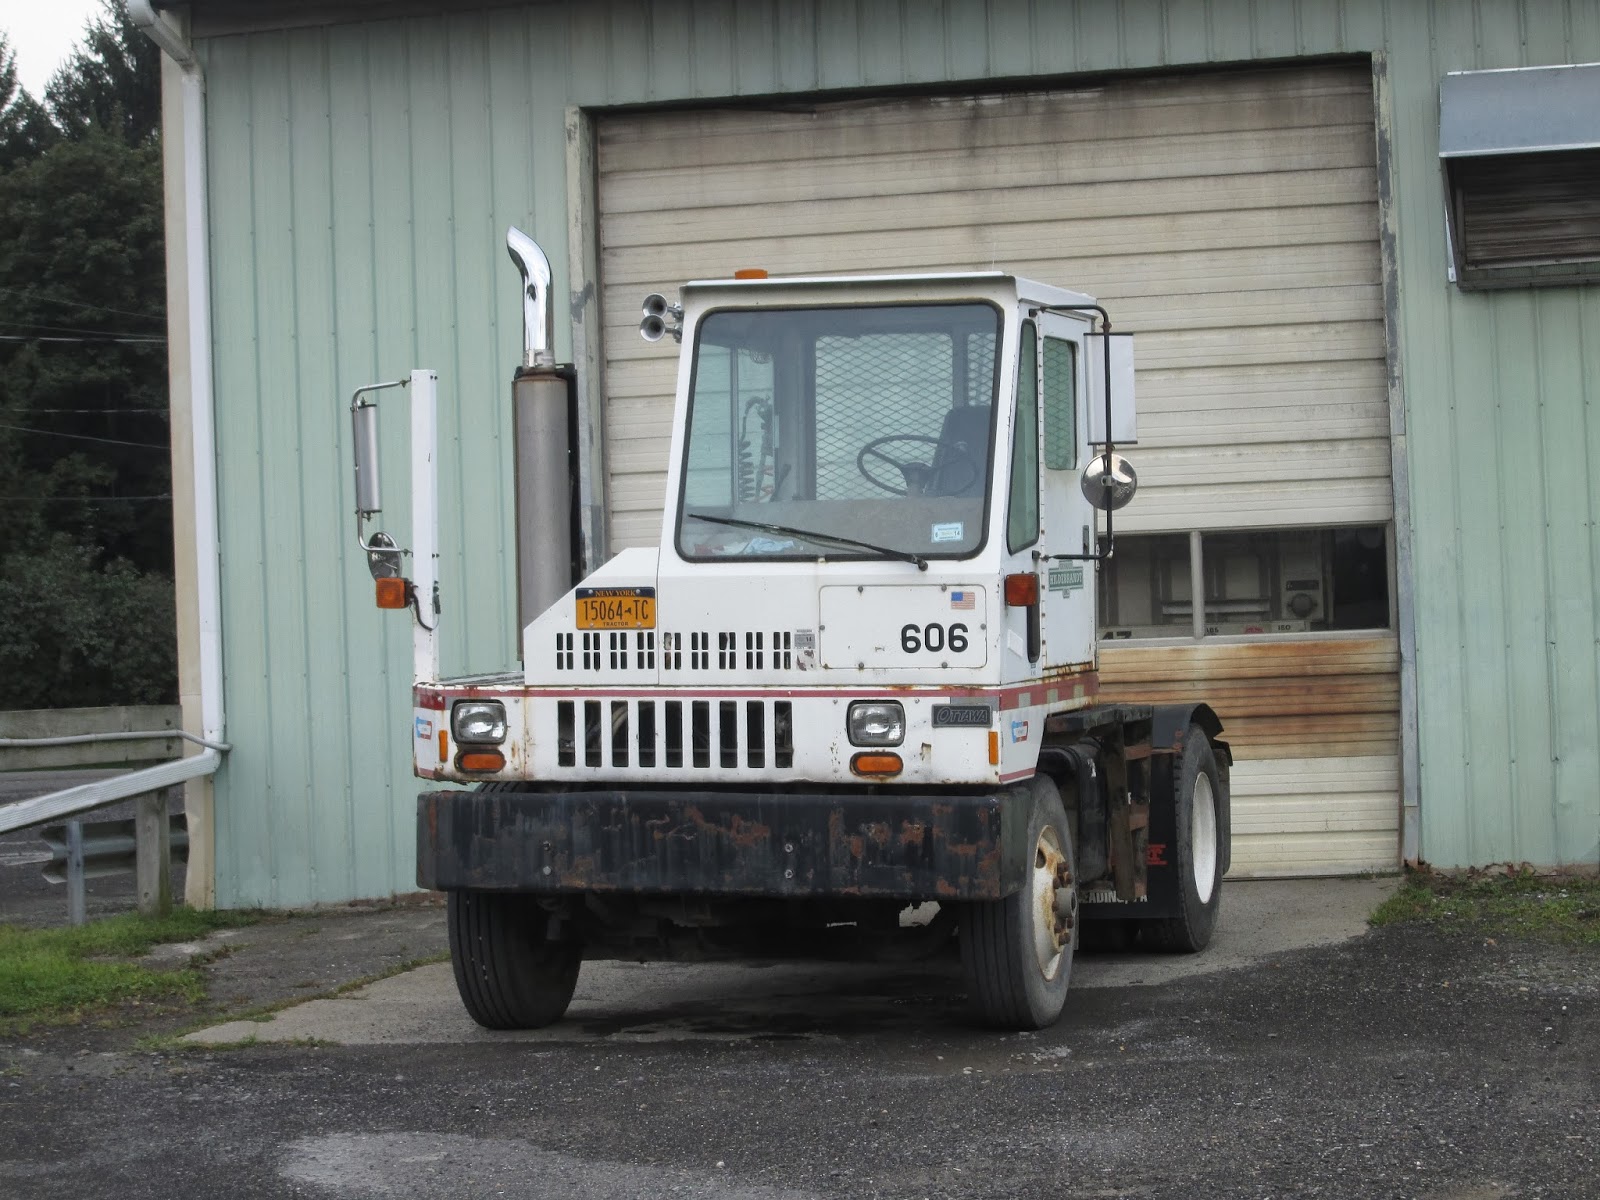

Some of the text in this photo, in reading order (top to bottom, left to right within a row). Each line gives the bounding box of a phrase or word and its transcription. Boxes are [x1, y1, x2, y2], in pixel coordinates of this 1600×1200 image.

[615, 589, 636, 597] YORK
[900, 622, 969, 654] 606
[936, 706, 989, 724] OTTAWA
